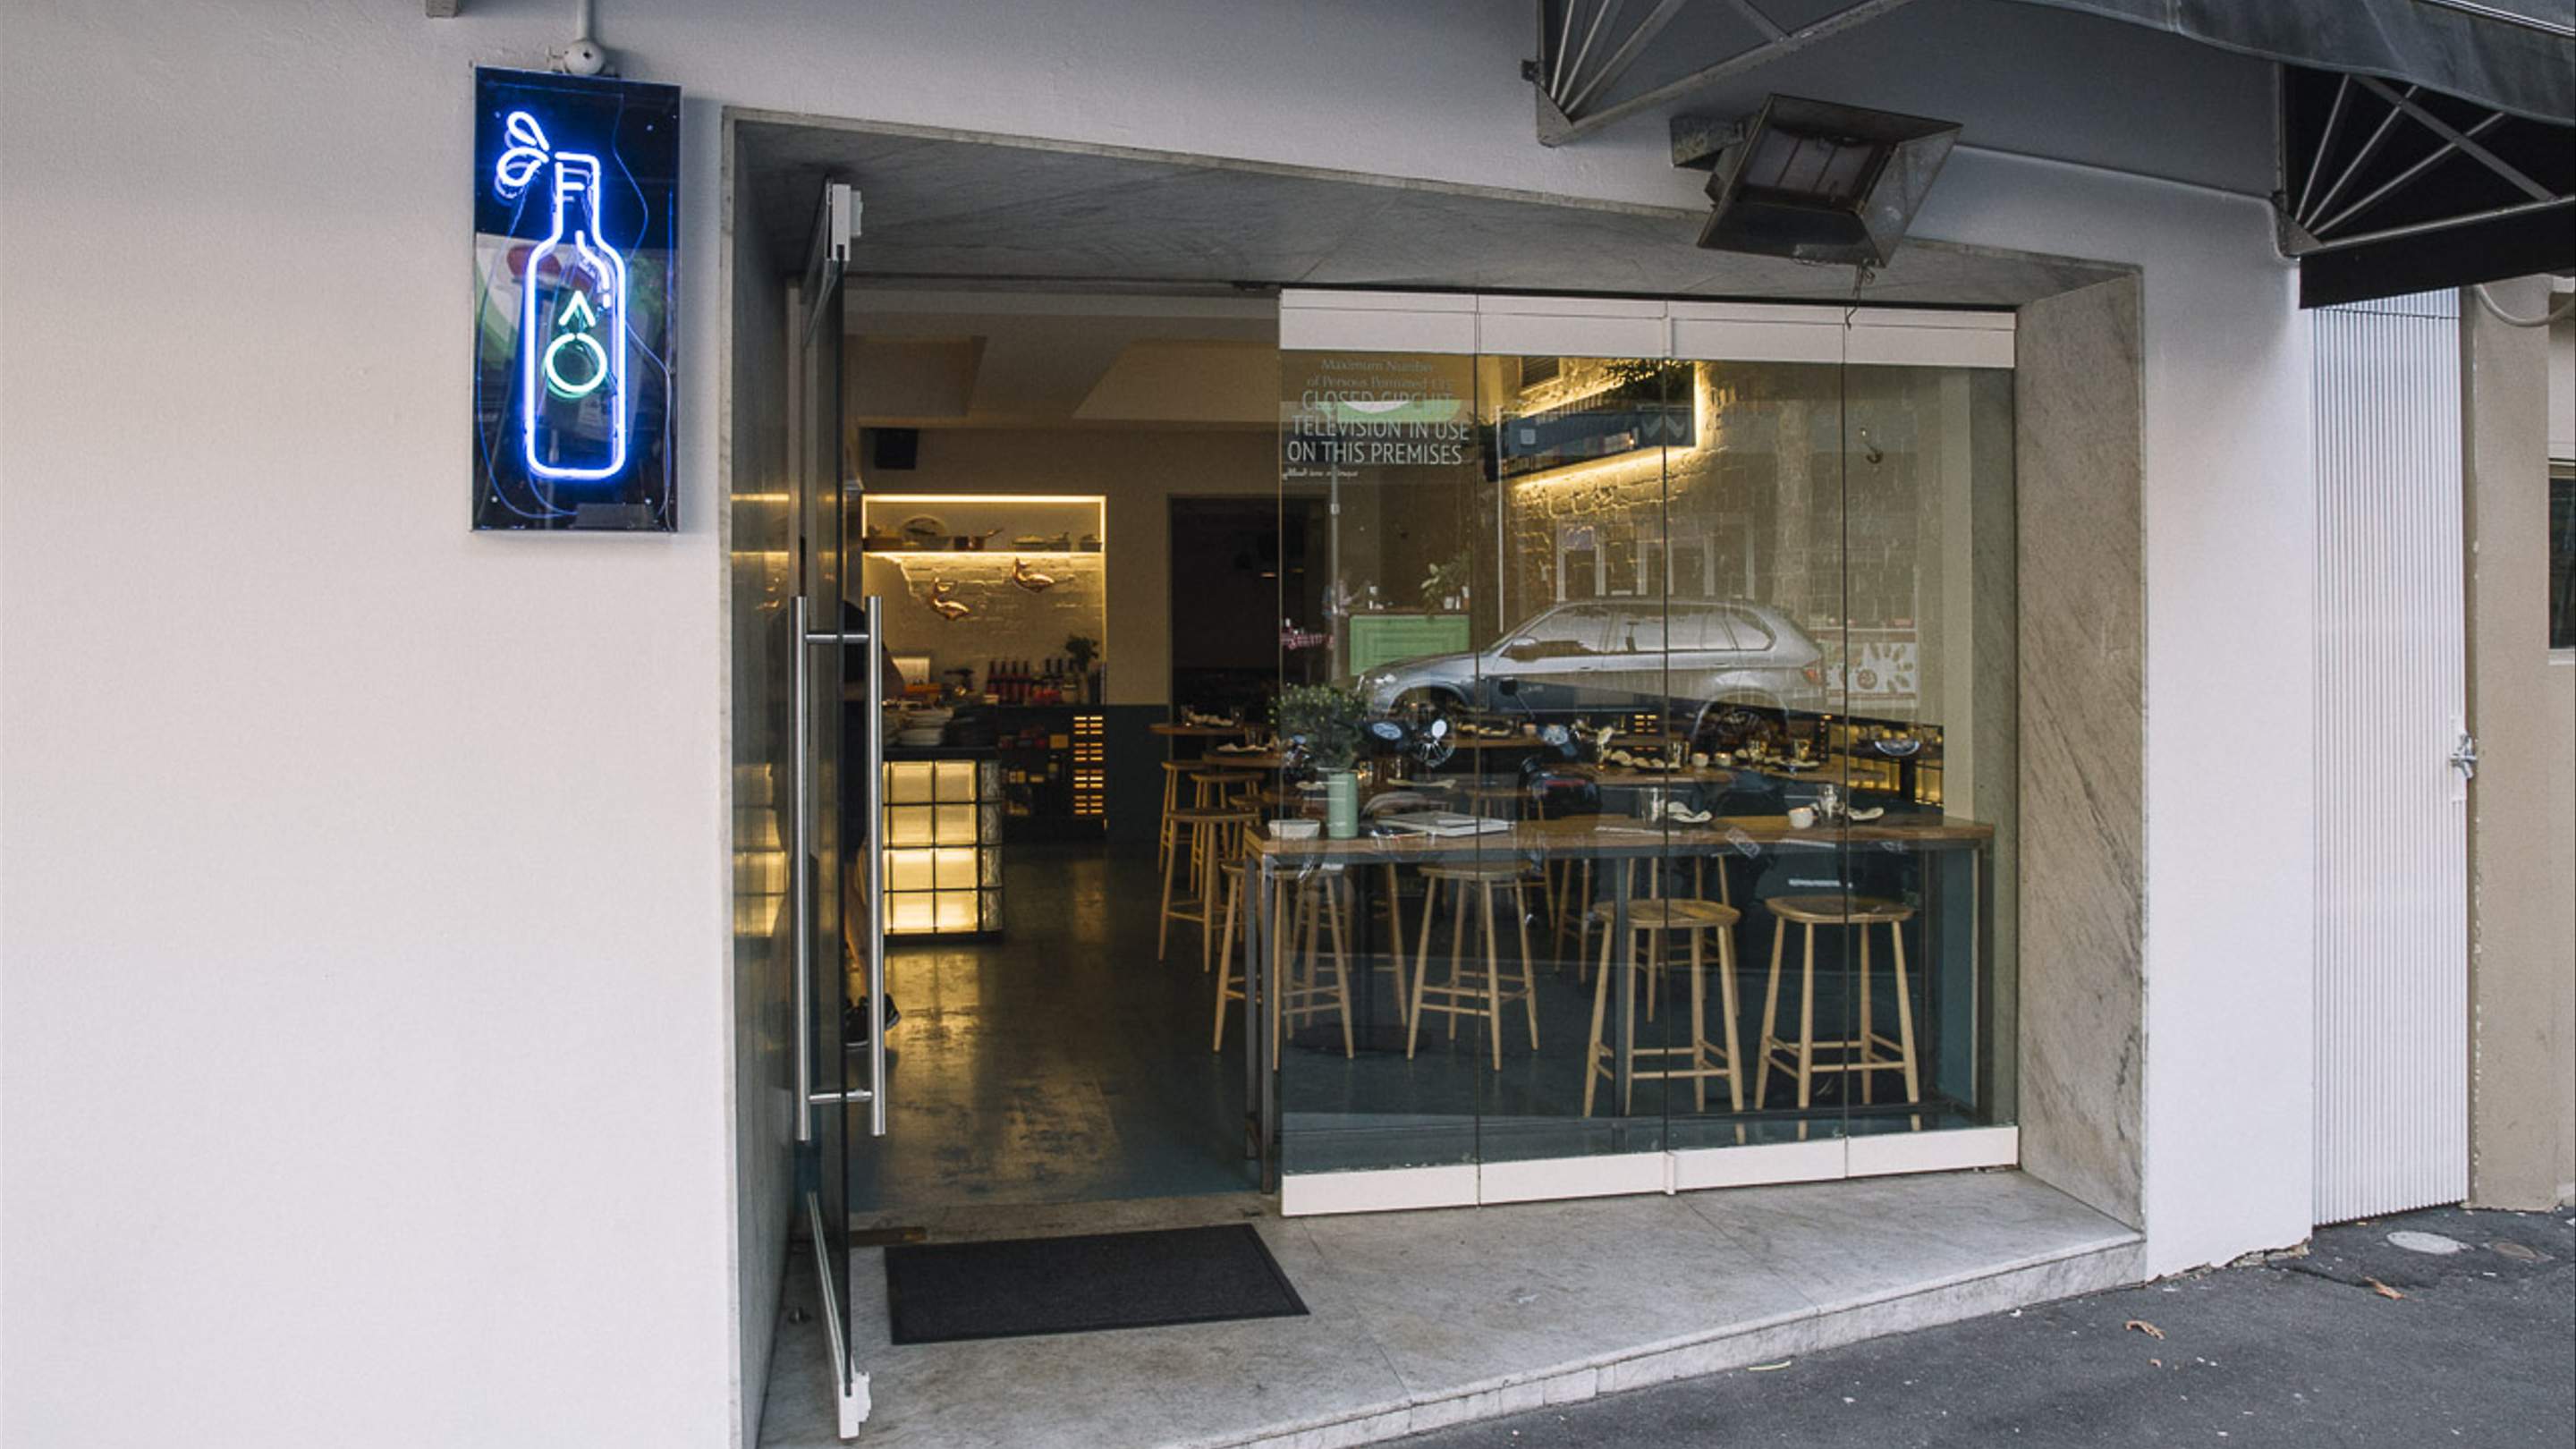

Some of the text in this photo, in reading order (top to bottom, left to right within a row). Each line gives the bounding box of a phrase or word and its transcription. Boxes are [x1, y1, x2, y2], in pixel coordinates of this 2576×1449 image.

[1321, 360, 1384, 371] Maximum
[1306, 376, 1321, 387] of
[1302, 390, 1375, 411] CLOSED
[1292, 415, 1470, 441] TELEVISION IN USE
[1287, 441, 1462, 465] ON THIS PREMISES
